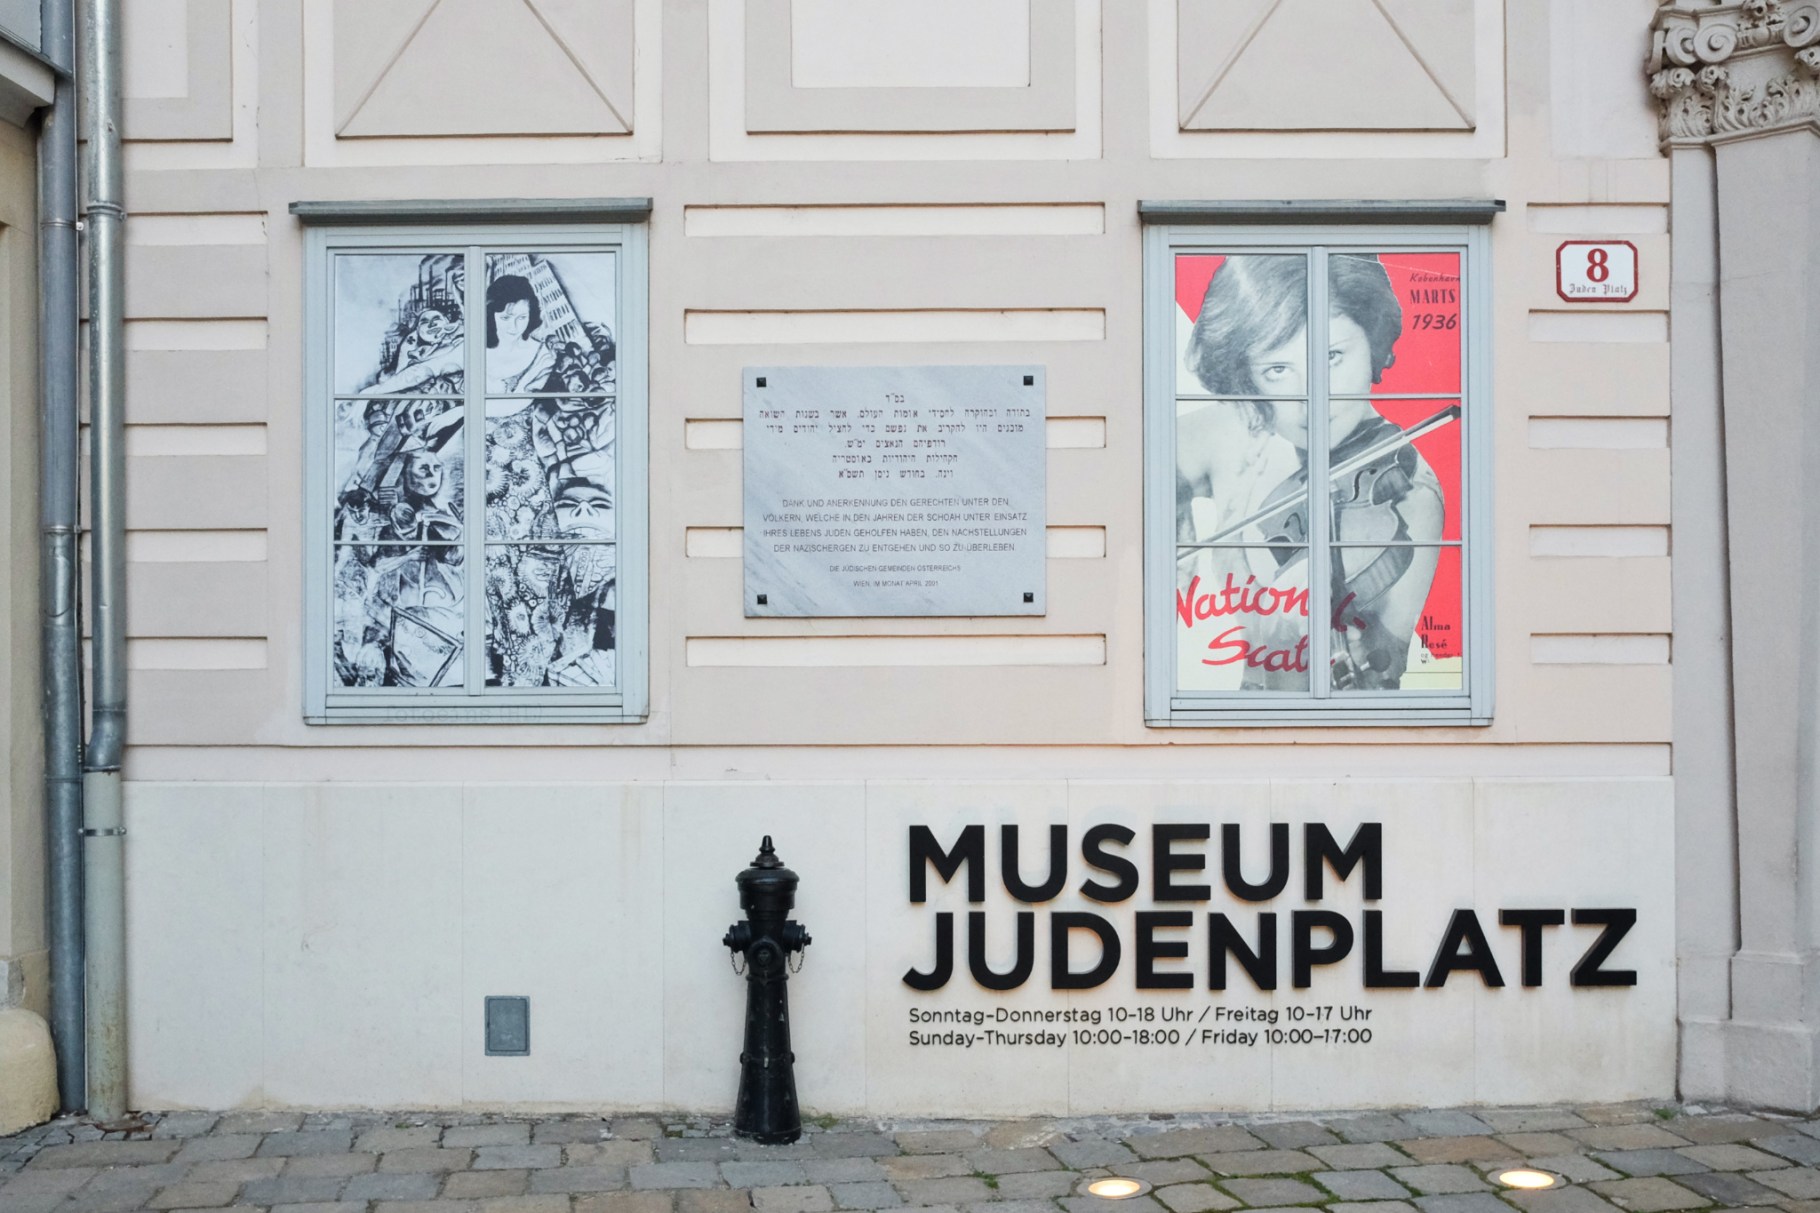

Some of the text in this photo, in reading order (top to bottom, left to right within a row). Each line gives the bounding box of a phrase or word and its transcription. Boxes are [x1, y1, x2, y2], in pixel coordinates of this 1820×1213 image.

[1587, 248, 1609, 282] 8
[1569, 283, 1627, 295] Juden Platz
[1410, 289, 1456, 304] MARTS
[1412, 313, 1458, 330] 1936
[758, 409, 786, 420] השואה
[794, 409, 820, 419] בשנות
[829, 408, 846, 419] אשר
[893, 408, 919, 419] אומות
[916, 423, 928, 433] את
[782, 498, 1010, 508] DANK UND ANERKENNUNG DEN GERECHTEN UNTER DEN
[805, 512, 840, 523] WELCHE
[842, 512, 852, 523] IN
[853, 512, 871, 523] DEN
[872, 512, 905, 523] JAHREN
[906, 512, 924, 523] DER
[926, 512, 961, 523] SCHOAH
[962, 512, 991, 523] UNTER
[993, 512, 1028, 523] EINSATZ
[762, 528, 788, 538] IHRES
[789, 528, 823, 538] LEBENS
[824, 528, 852, 538] JUDEN
[853, 528, 898, 538] GEHOLFEN
[931, 528, 950, 538] DEN
[951, 528, 1028, 538] NACHSTELLUNGEN
[773, 543, 791, 553] DER
[792, 543, 857, 553] NAZISCHERGEN
[858, 543, 870, 553] ZU
[871, 543, 917, 553] ENTGEHEN
[918, 543, 937, 553] UND
[938, 543, 951, 553] SO
[952, 543, 964, 553] ZU
[828, 564, 840, 573] DIE
[881, 579, 904, 588] MONAT
[904, 579, 923, 588] APRIL
[1421, 615, 1451, 631] Alma
[1421, 634, 1448, 649] Rosé
[909, 822, 1382, 903] MUSEUM
[902, 908, 1637, 991] JUDENPLATZ
[909, 1006, 1372, 1025] Sonntag-Donnerstag 10-18 Uhr / Freitag 10-17 Uhr
[909, 1028, 1372, 1048] Sunday-Thursday 10:00-18:00 / Friday 10:00-17:00
